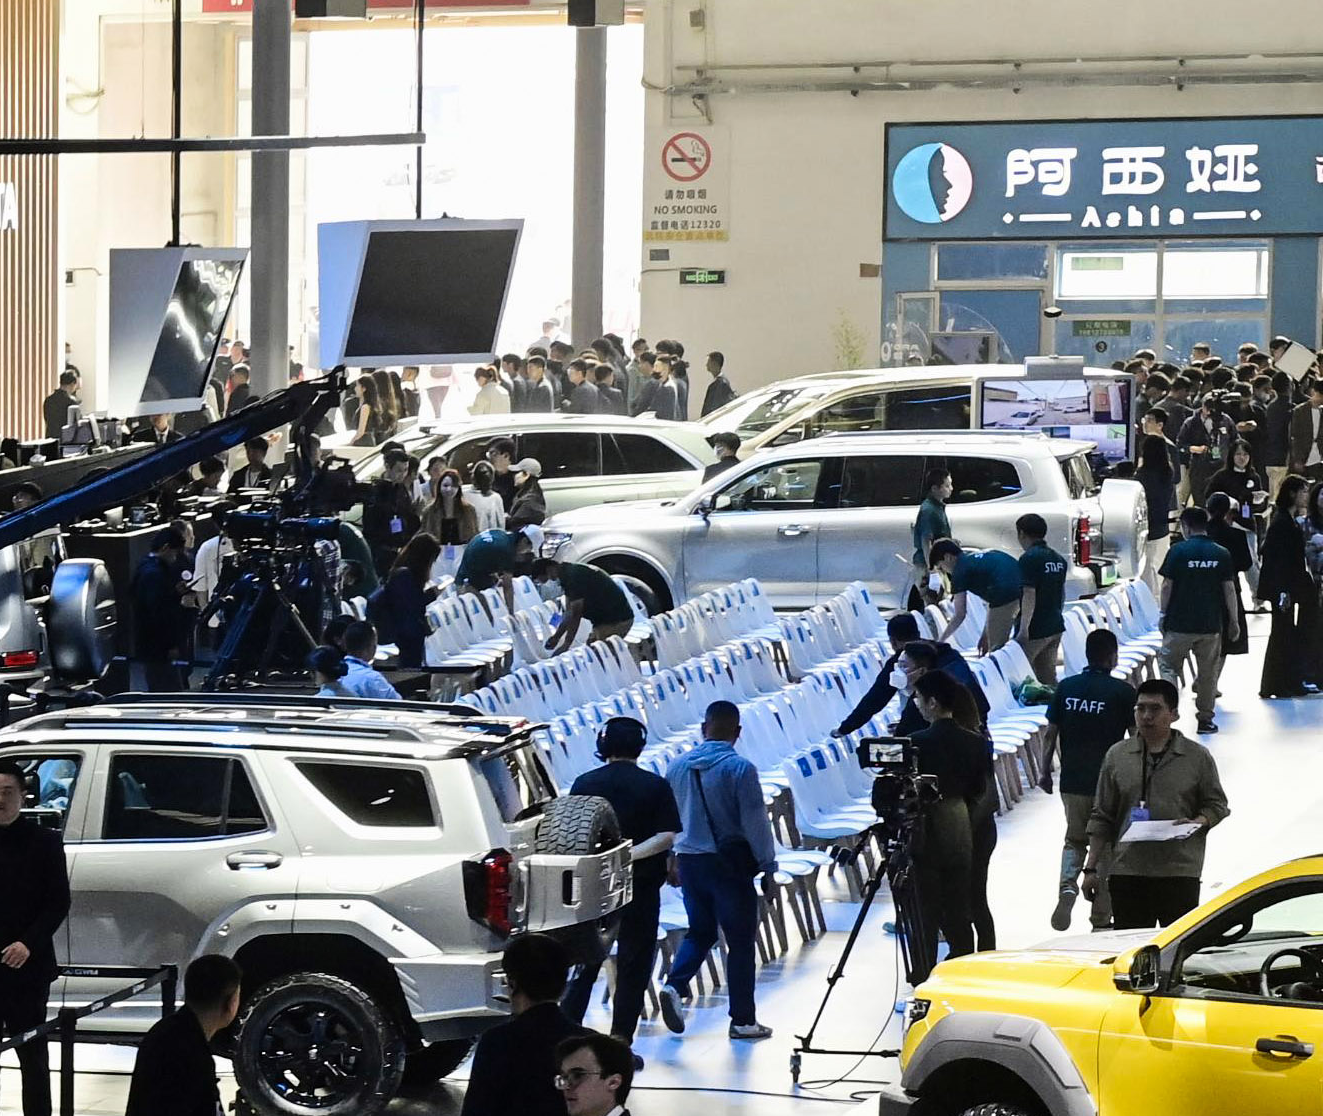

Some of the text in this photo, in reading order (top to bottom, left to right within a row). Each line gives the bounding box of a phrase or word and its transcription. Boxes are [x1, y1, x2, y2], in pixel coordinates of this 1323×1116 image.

[1005, 144, 1262, 198] 阿西娅
[665, 189, 707, 200] 请勿吸烟
[653, 205, 718, 215] NO SMOKING
[1188, 560, 1219, 569] STAFF
[1064, 697, 1106, 715] STAFF
[74, 968, 98, 976] GWM
